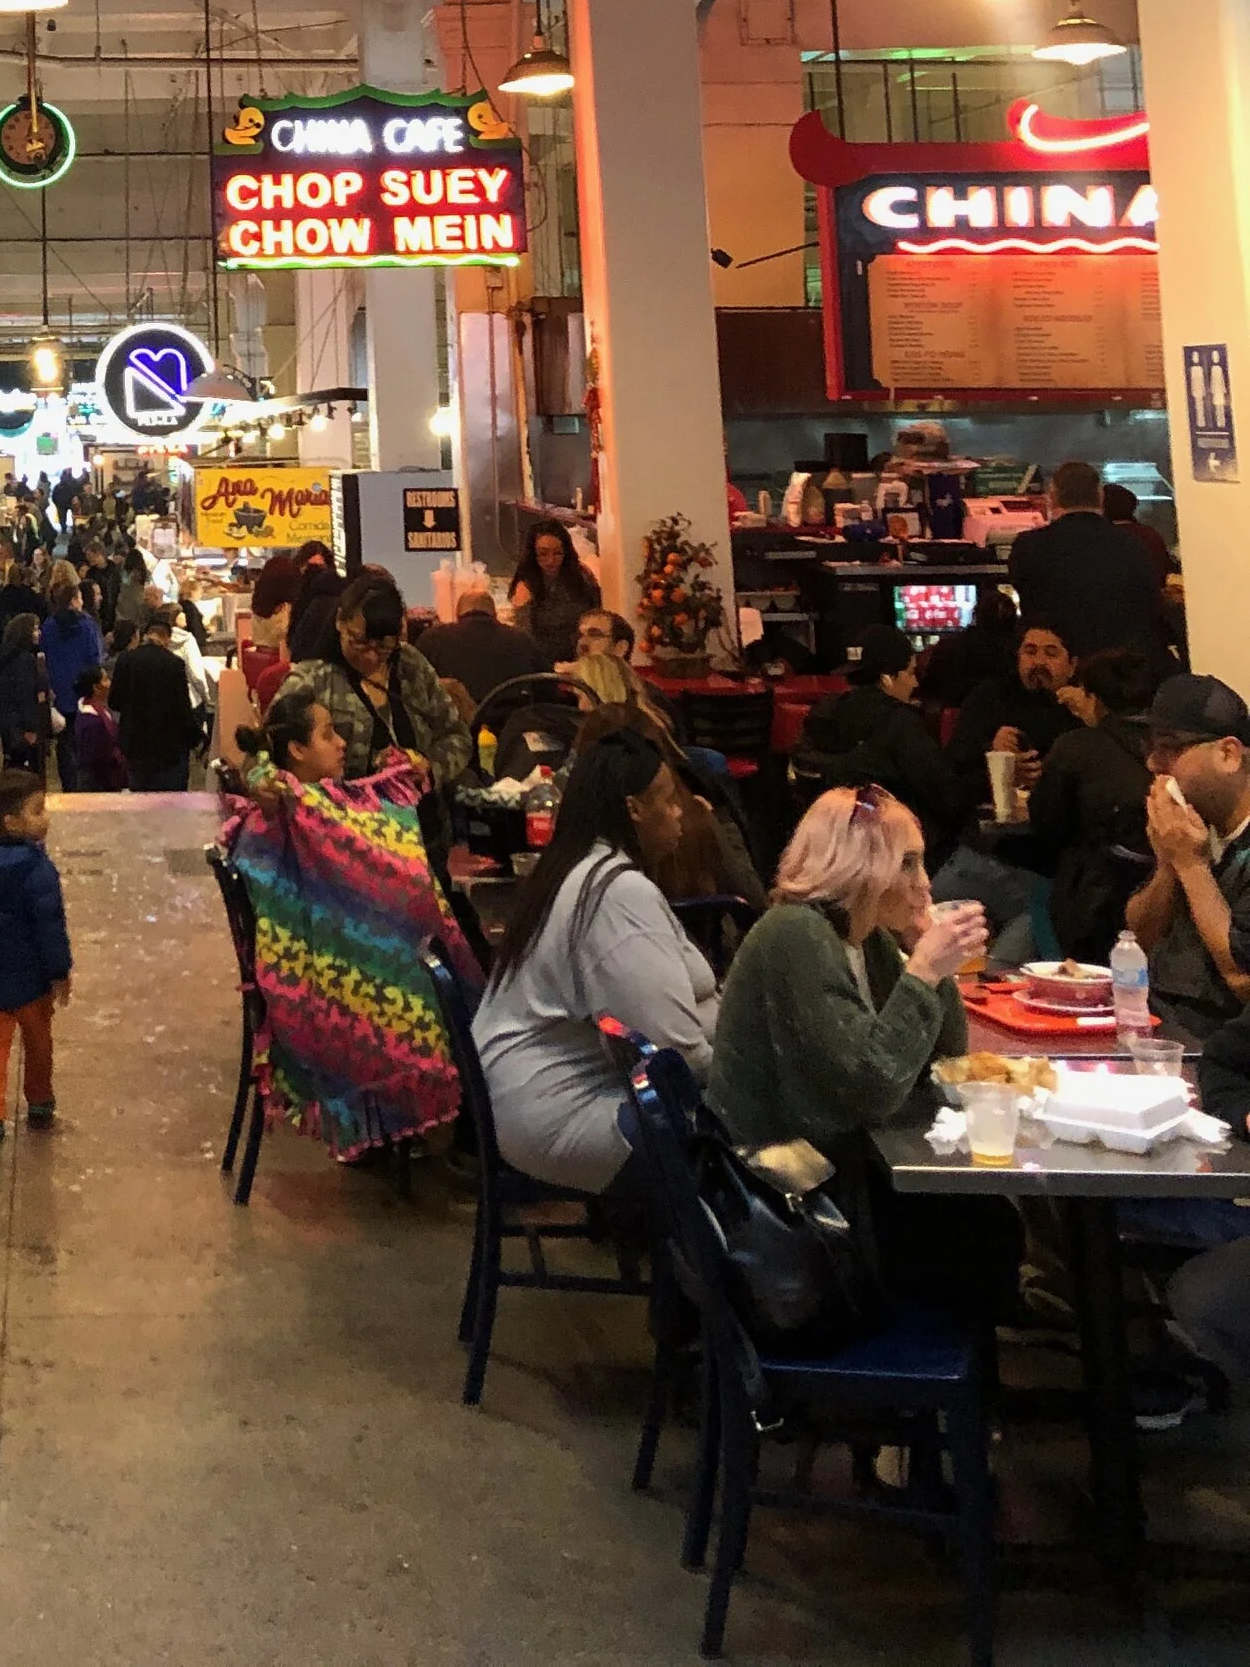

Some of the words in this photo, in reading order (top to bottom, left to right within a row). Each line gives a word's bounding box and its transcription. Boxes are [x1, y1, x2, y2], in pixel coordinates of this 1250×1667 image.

[271, 118, 373, 154] CHINA
[383, 117, 465, 153] CAFE
[226, 171, 363, 210] CHOP
[381, 168, 509, 206] SUEY
[229, 217, 371, 255] CHOW
[394, 214, 514, 252] MEIN
[200, 476, 258, 510] Ana
[260, 487, 331, 518] Maria
